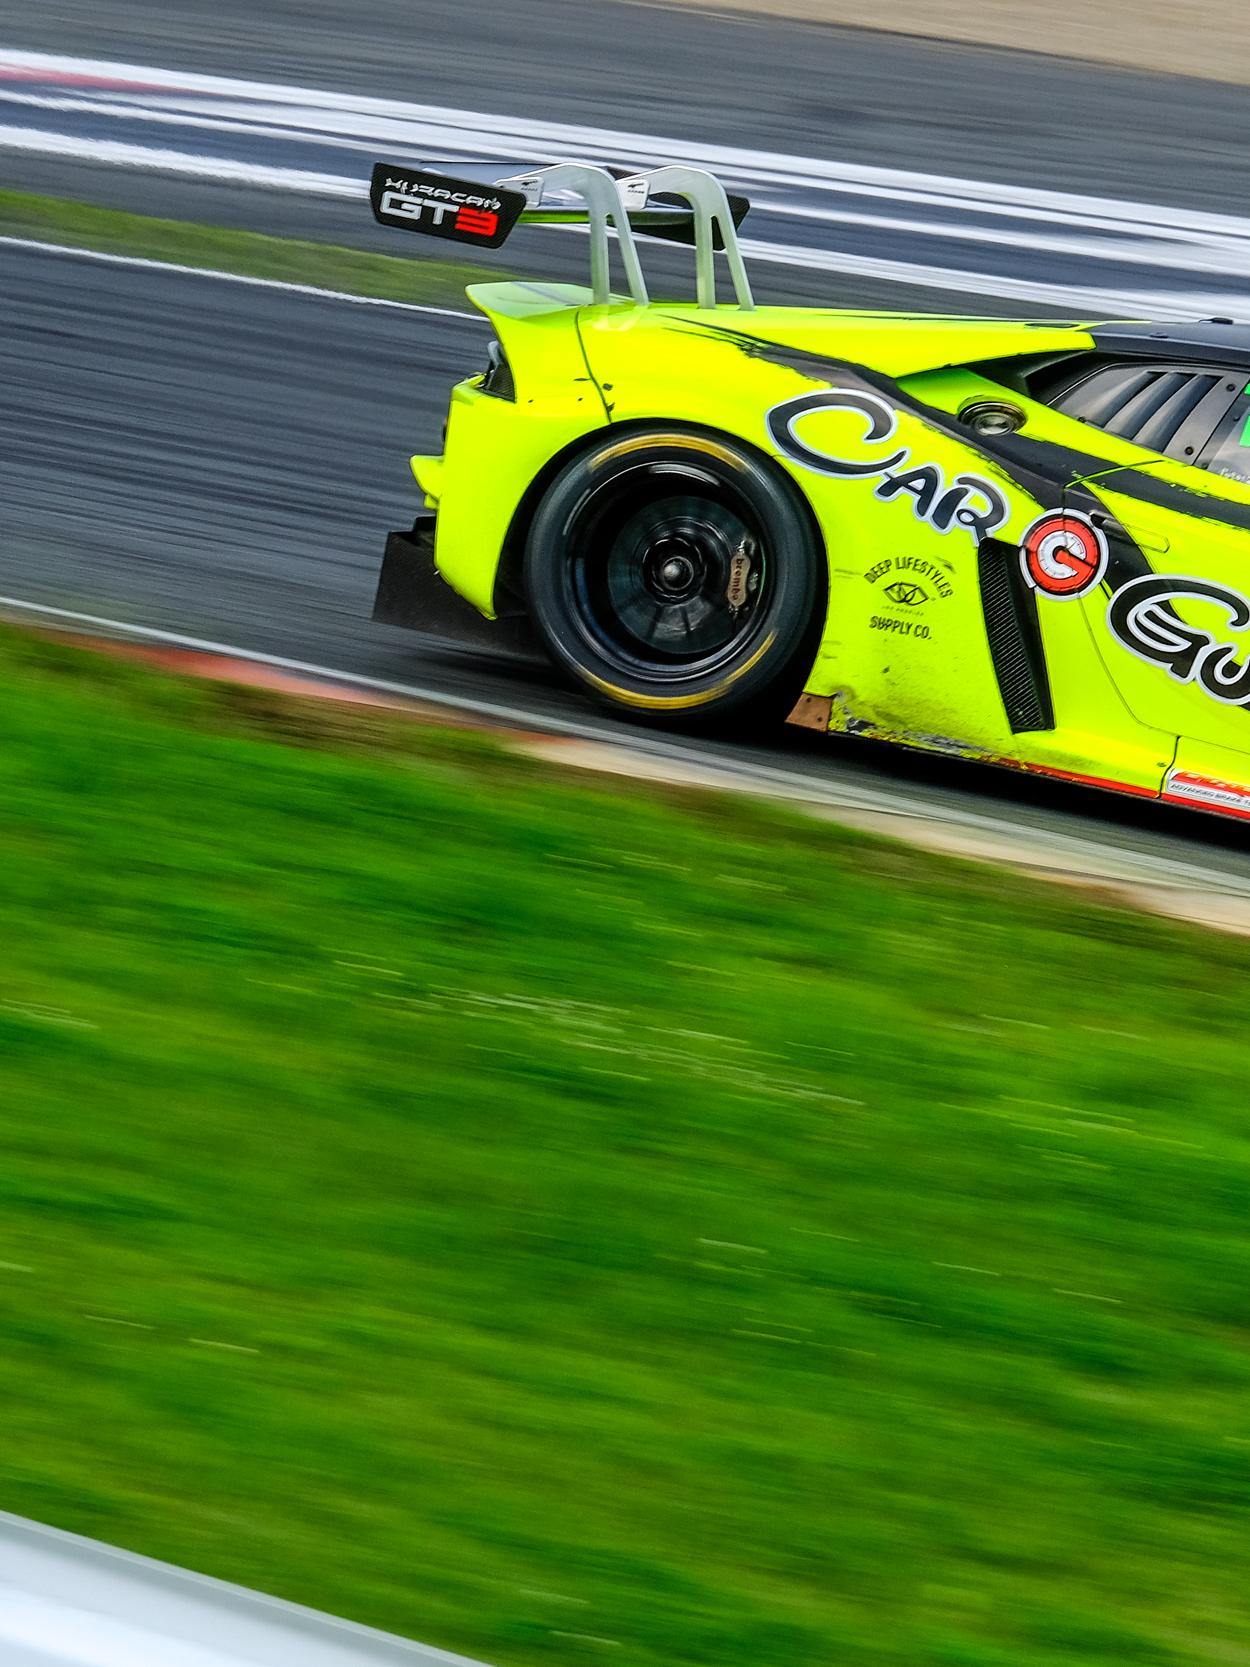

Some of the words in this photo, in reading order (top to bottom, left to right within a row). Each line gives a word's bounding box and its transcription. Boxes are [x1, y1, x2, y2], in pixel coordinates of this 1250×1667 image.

[380, 191, 498, 236] GT3
[765, 388, 1010, 547] CAR
[863, 559, 892, 584] DEEP
[895, 556, 953, 598] LIFESTYLES
[869, 615, 913, 635] SUPPLY
